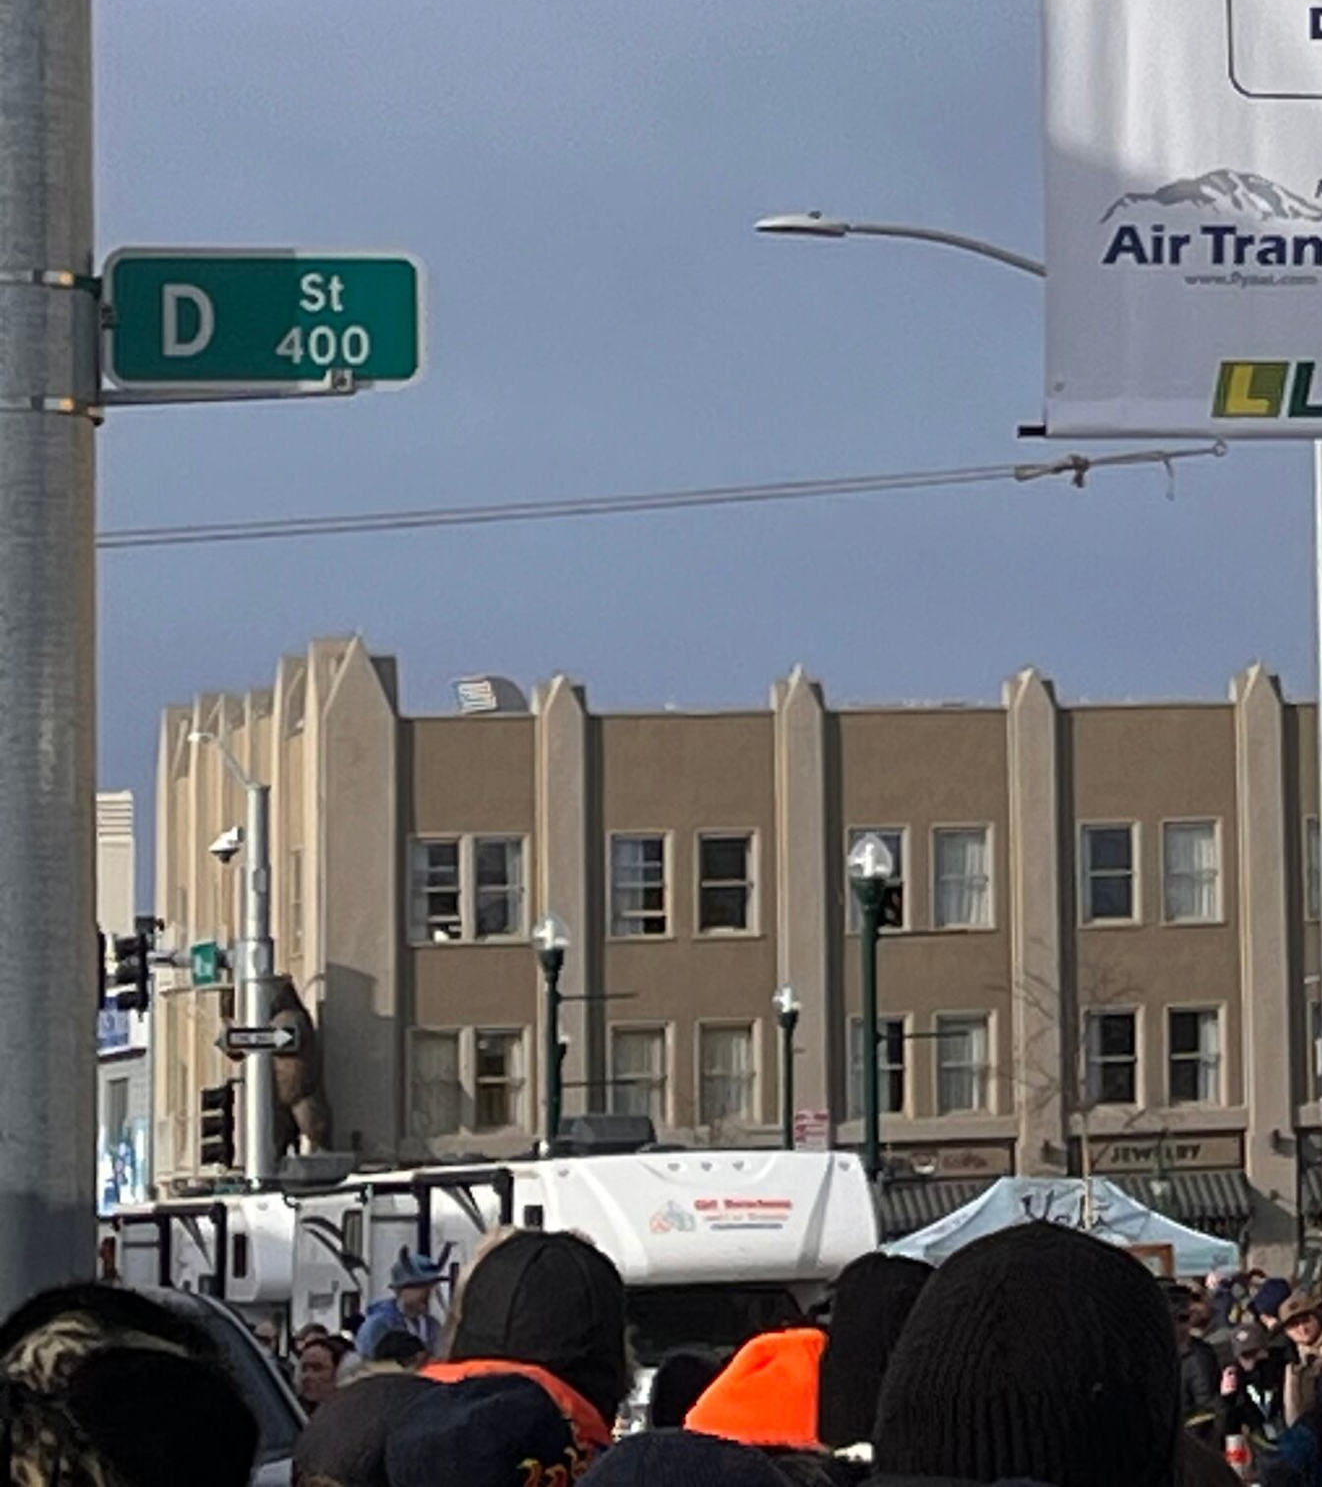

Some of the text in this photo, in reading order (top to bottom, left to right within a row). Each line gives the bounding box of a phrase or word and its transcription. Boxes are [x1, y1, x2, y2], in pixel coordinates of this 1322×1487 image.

[1102, 224, 1191, 266] Air
[299, 273, 346, 313] St
[162, 284, 215, 357] D
[275, 325, 371, 365] 400
